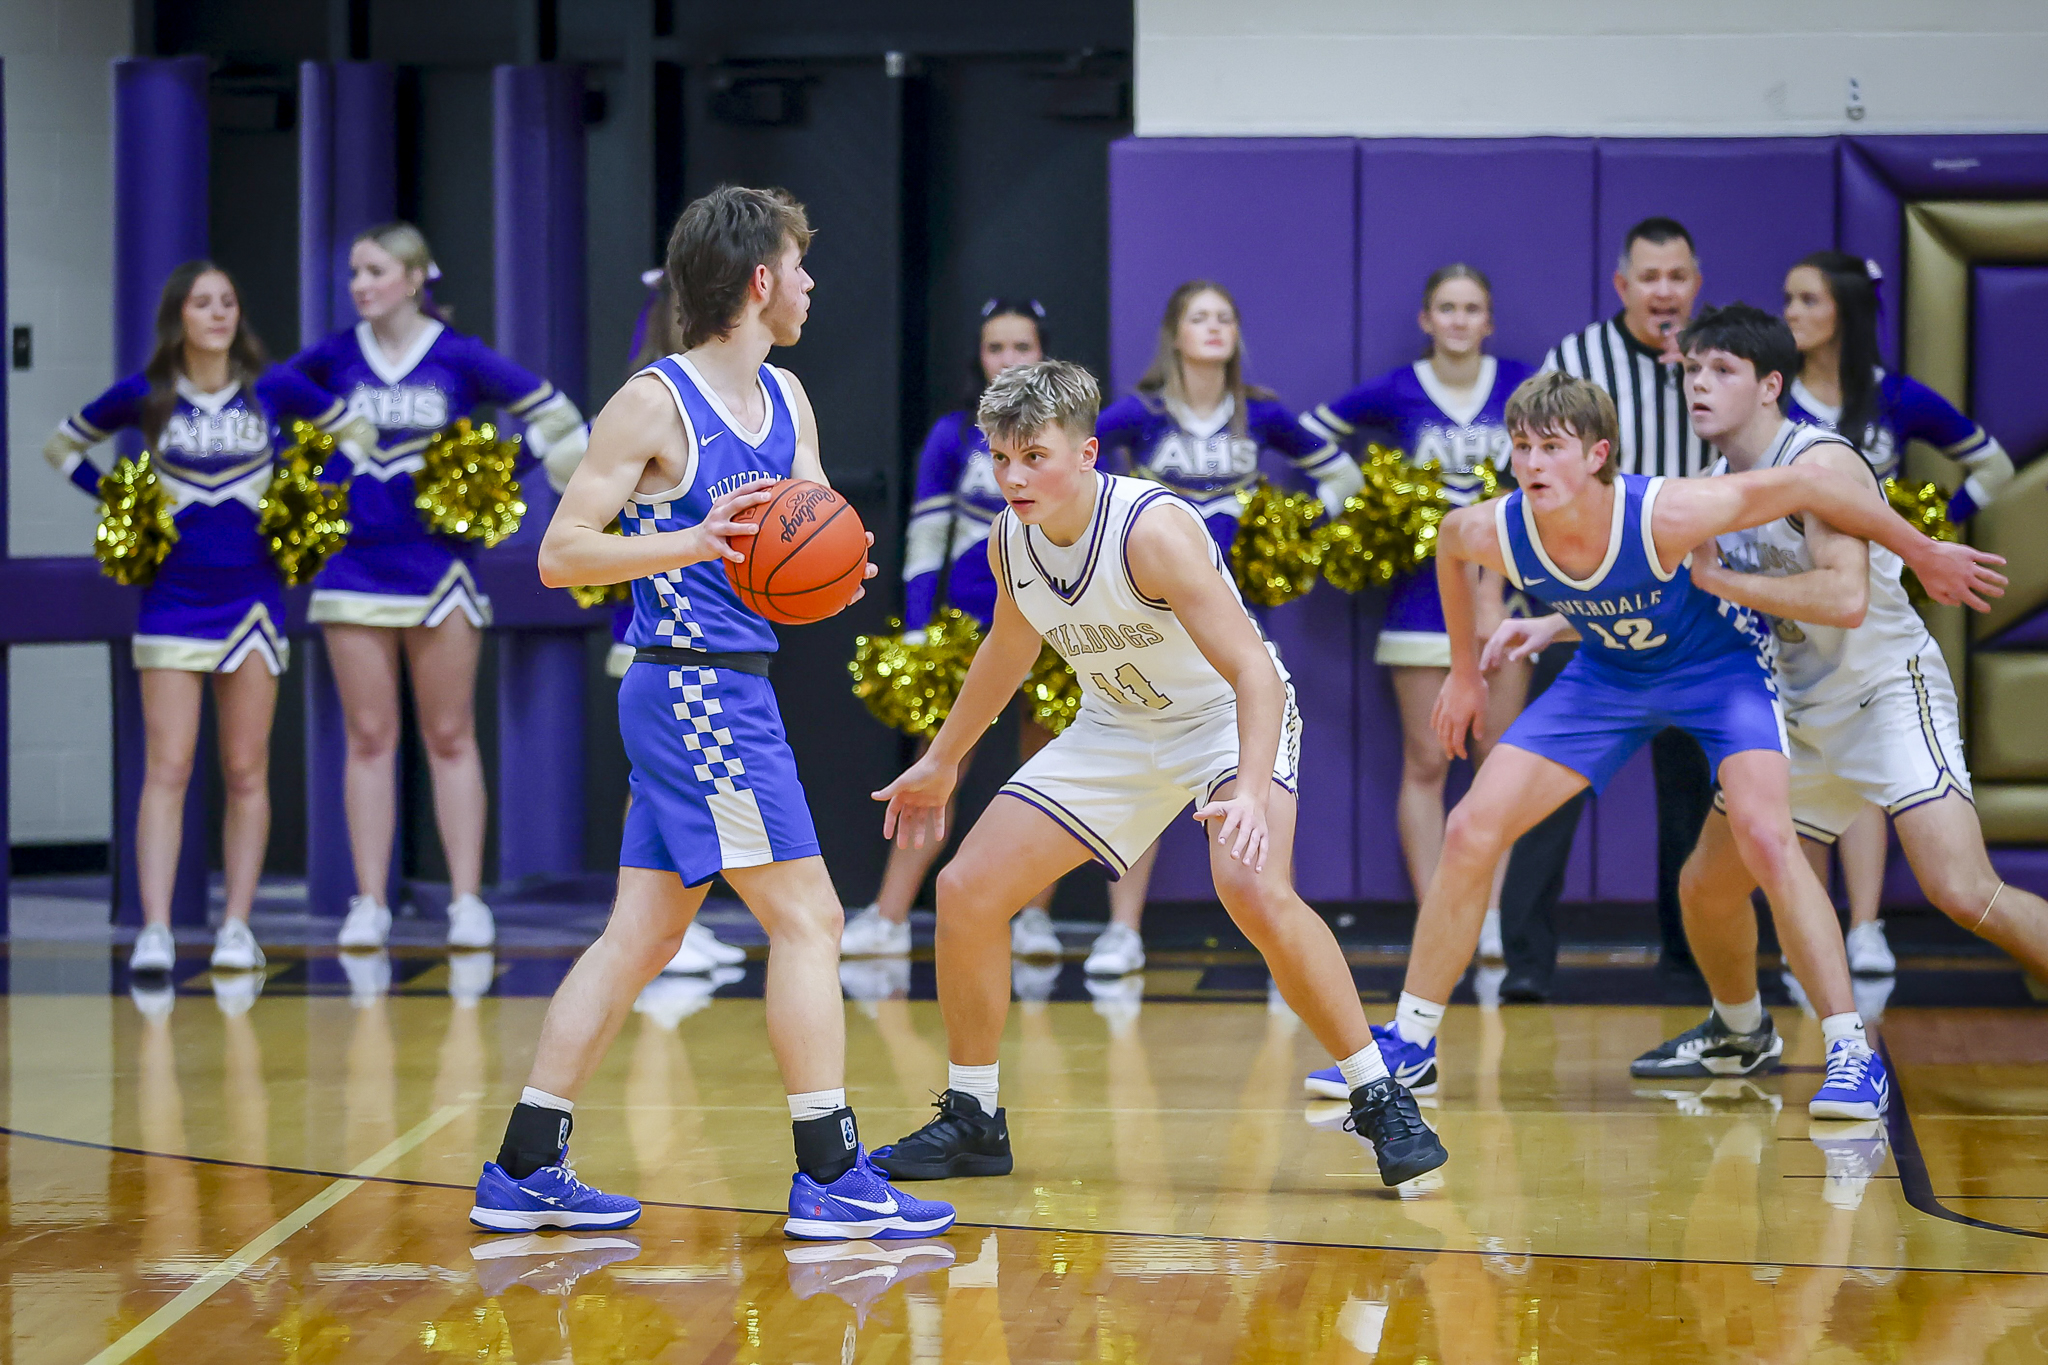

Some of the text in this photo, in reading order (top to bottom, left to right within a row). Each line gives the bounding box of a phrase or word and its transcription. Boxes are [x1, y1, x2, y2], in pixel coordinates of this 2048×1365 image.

[351, 388, 447, 427] AHS
[1153, 437, 1257, 475] AHS
[780, 484, 836, 543] Rawlings
[1044, 622, 1164, 658] ULLDOGS
[1587, 617, 1668, 651] 12
[1089, 662, 1174, 710] 11
